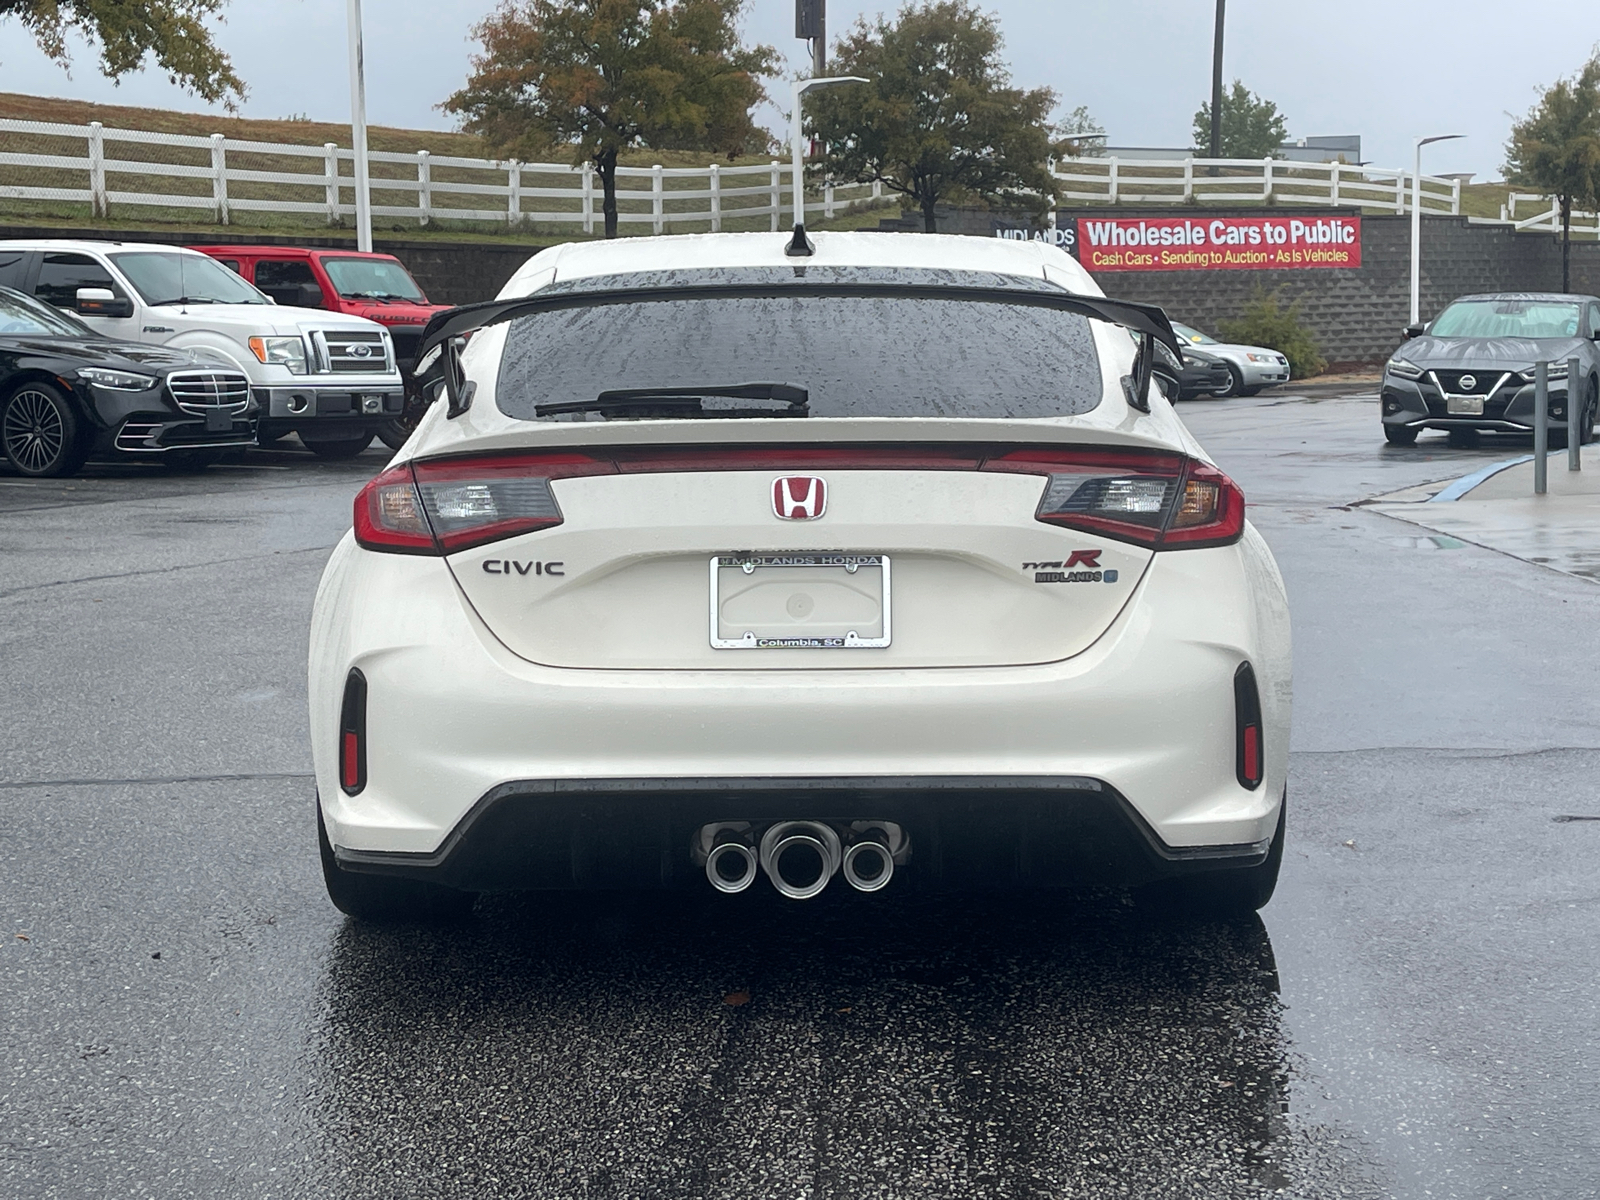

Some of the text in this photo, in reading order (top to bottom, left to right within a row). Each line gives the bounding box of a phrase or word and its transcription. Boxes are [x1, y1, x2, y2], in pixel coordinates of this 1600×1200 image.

[1086, 220, 1355, 246] Wholesale Cars to Public
[1092, 248, 1349, 267] Cash Cars Sending to Auction As Is Vehicles
[482, 559, 565, 576] CIVIC
[821, 555, 879, 565] HONDA
[1022, 549, 1102, 570] TYPE R
[1035, 572, 1102, 582] MIDLANDS
[824, 638, 843, 647] SC
